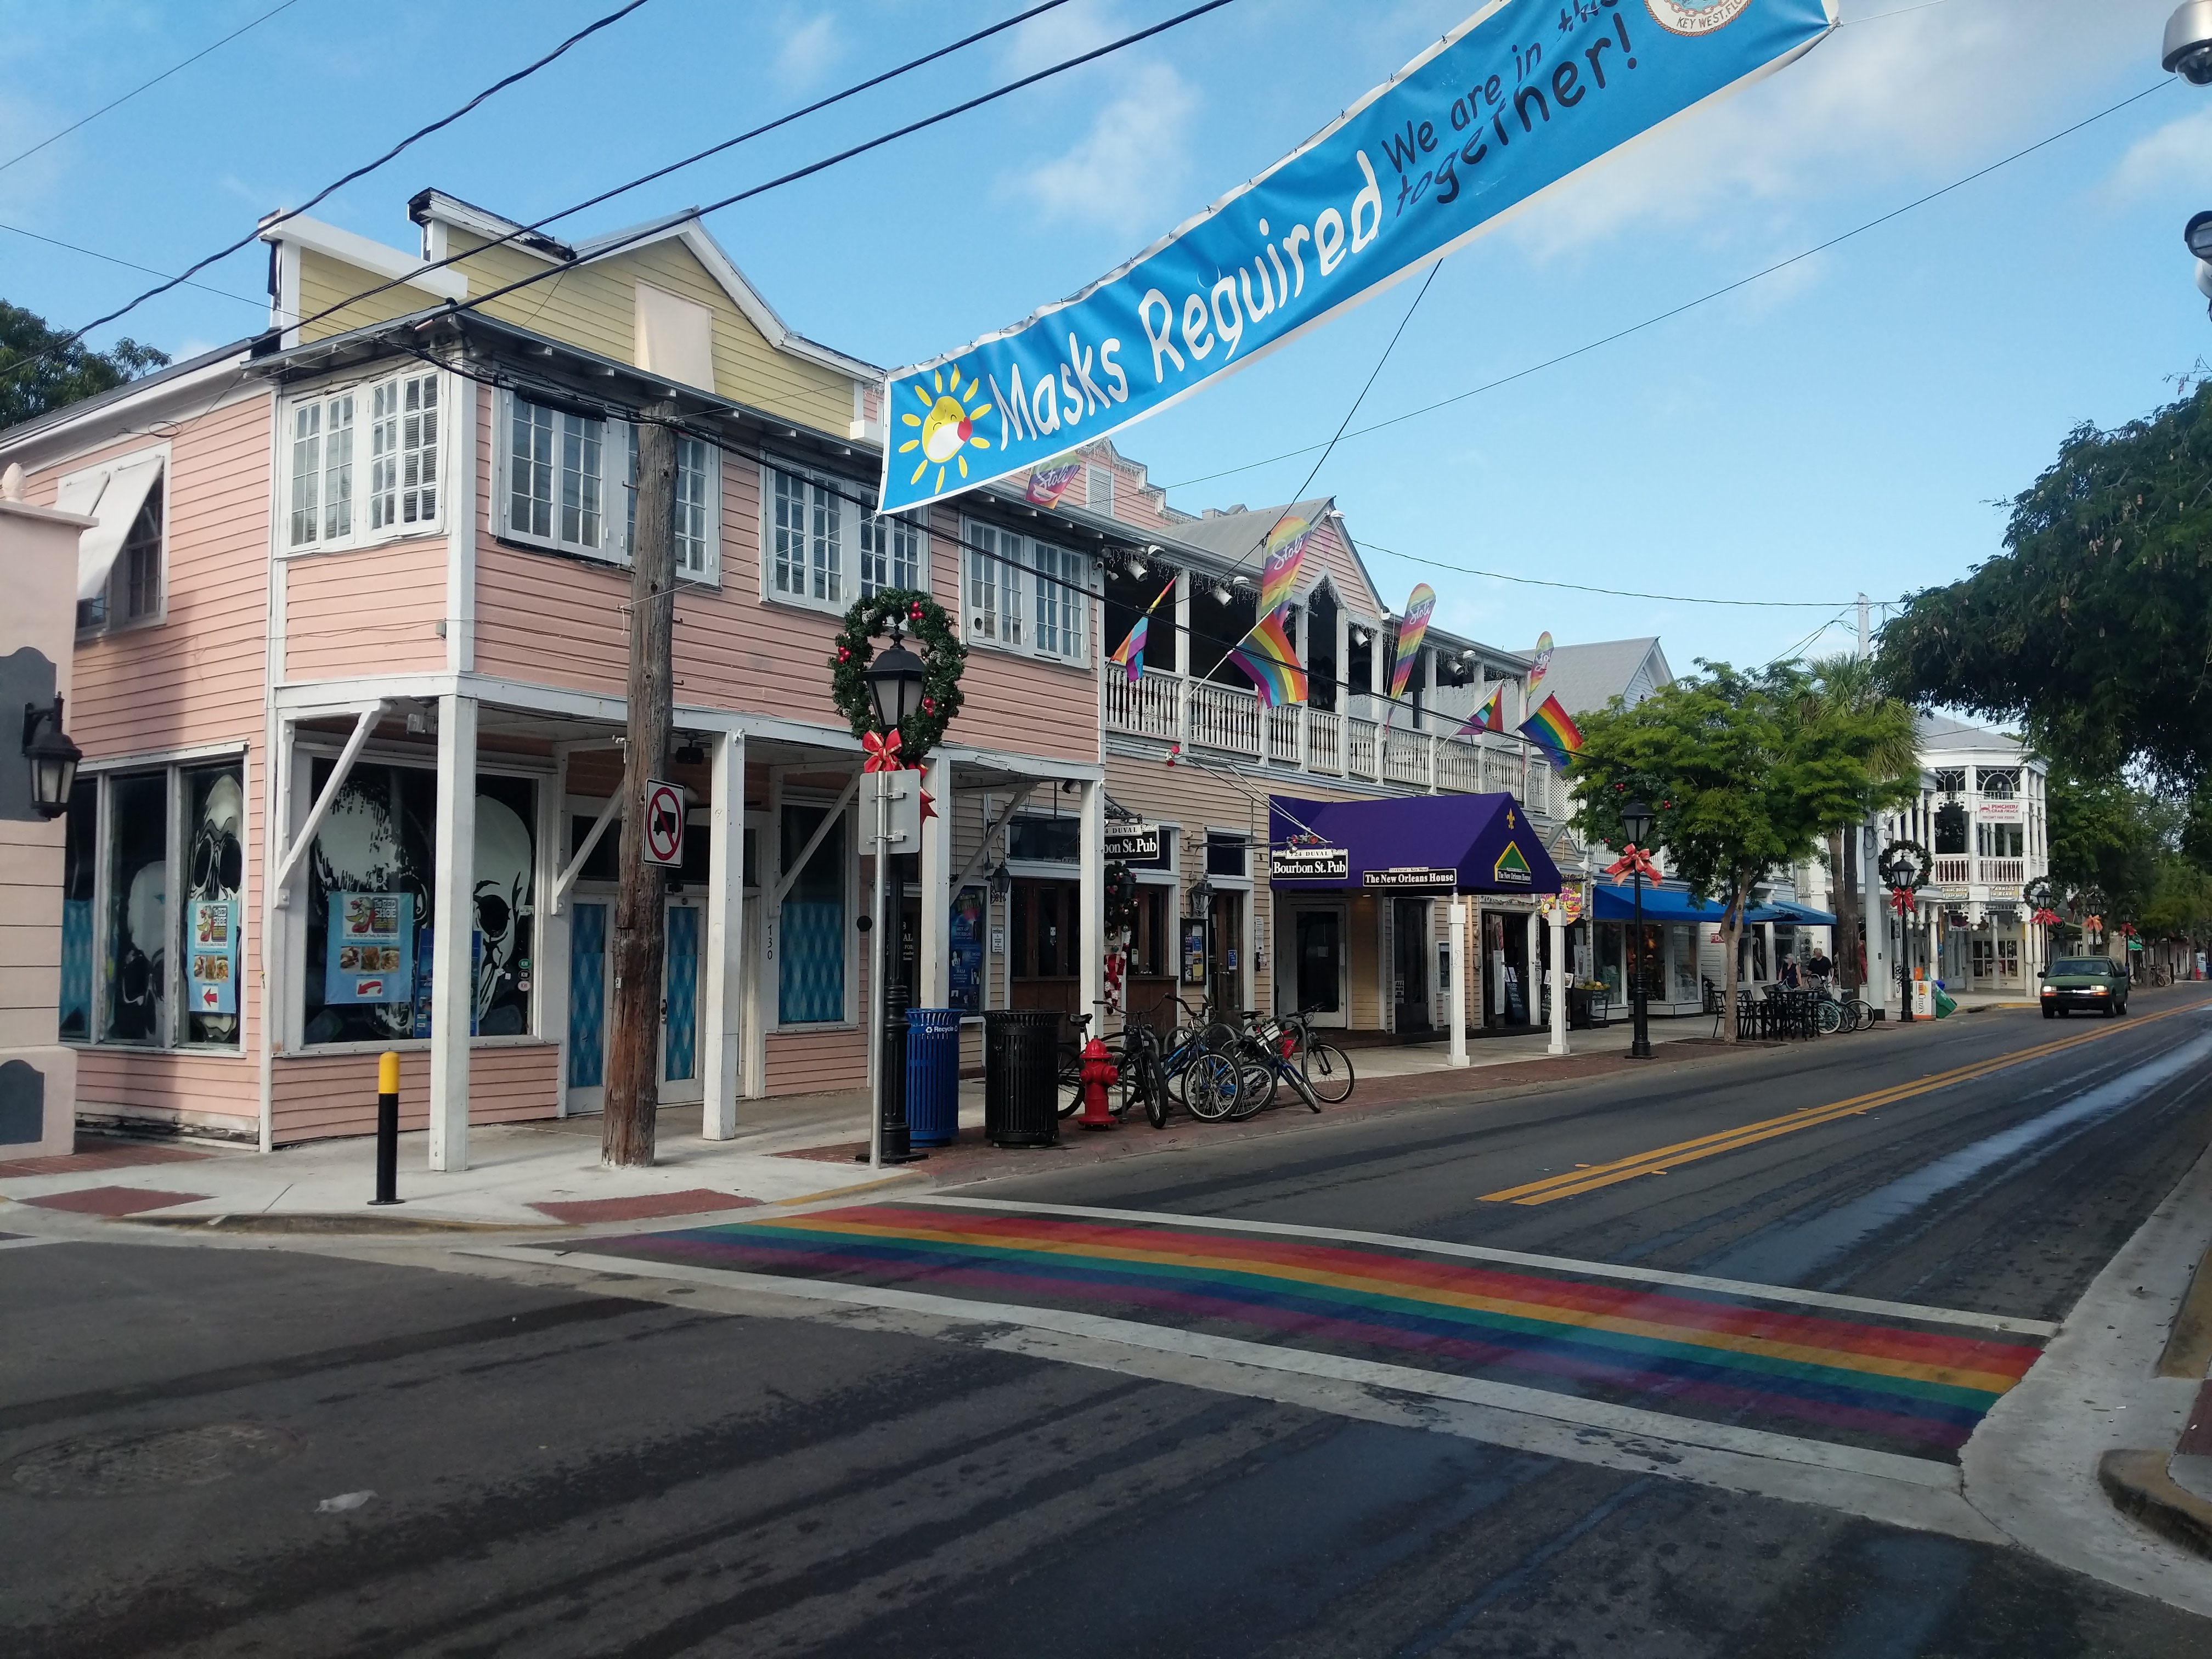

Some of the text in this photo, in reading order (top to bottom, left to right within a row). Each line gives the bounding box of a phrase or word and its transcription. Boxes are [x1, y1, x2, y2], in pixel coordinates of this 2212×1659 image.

[1677, 17, 1696, 29] KEY
[1381, 120, 1438, 173] We
[1451, 75, 1502, 131] are
[1512, 42, 1541, 83] in
[1396, 13, 1637, 217] together!
[989, 150, 1382, 451] Masks Required
[1034, 460, 1069, 490] Stoli
[1272, 534, 1305, 570] Stoli
[1409, 600, 1431, 624] Stoli
[1122, 839, 1136, 853] St.
[1136, 838, 1157, 853] Pub
[1273, 860, 1346, 873] Bourbon St. Pub
[1365, 873, 1454, 883] The New Orleans House
[383, 899, 396, 909] RED
[374, 909, 397, 918] SHOE
[213, 917, 227, 926] SHOE
